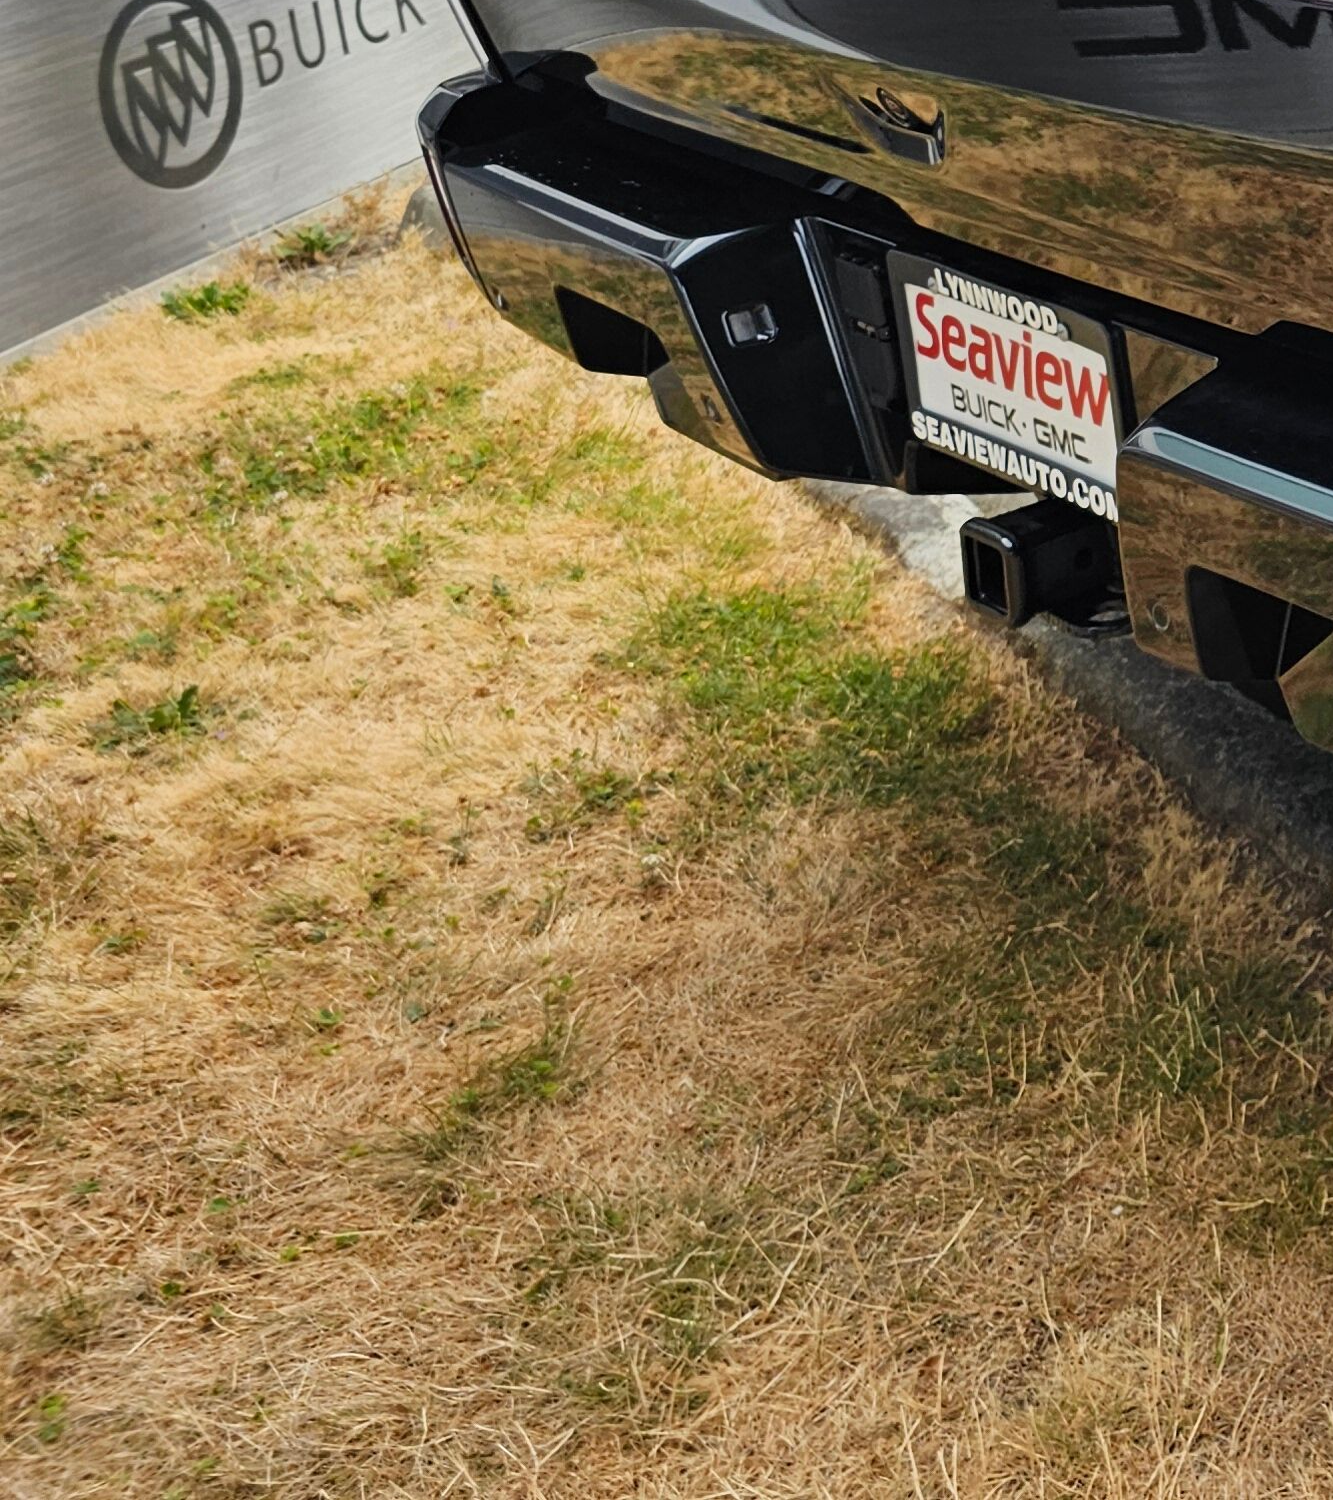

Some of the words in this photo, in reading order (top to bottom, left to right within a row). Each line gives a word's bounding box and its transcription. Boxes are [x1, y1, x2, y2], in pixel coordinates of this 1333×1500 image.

[932, 267, 1060, 335] LYNNWOOD
[915, 292, 1110, 427] Seaview
[950, 383, 1022, 437] BUICK
[1033, 417, 1093, 464] GMC
